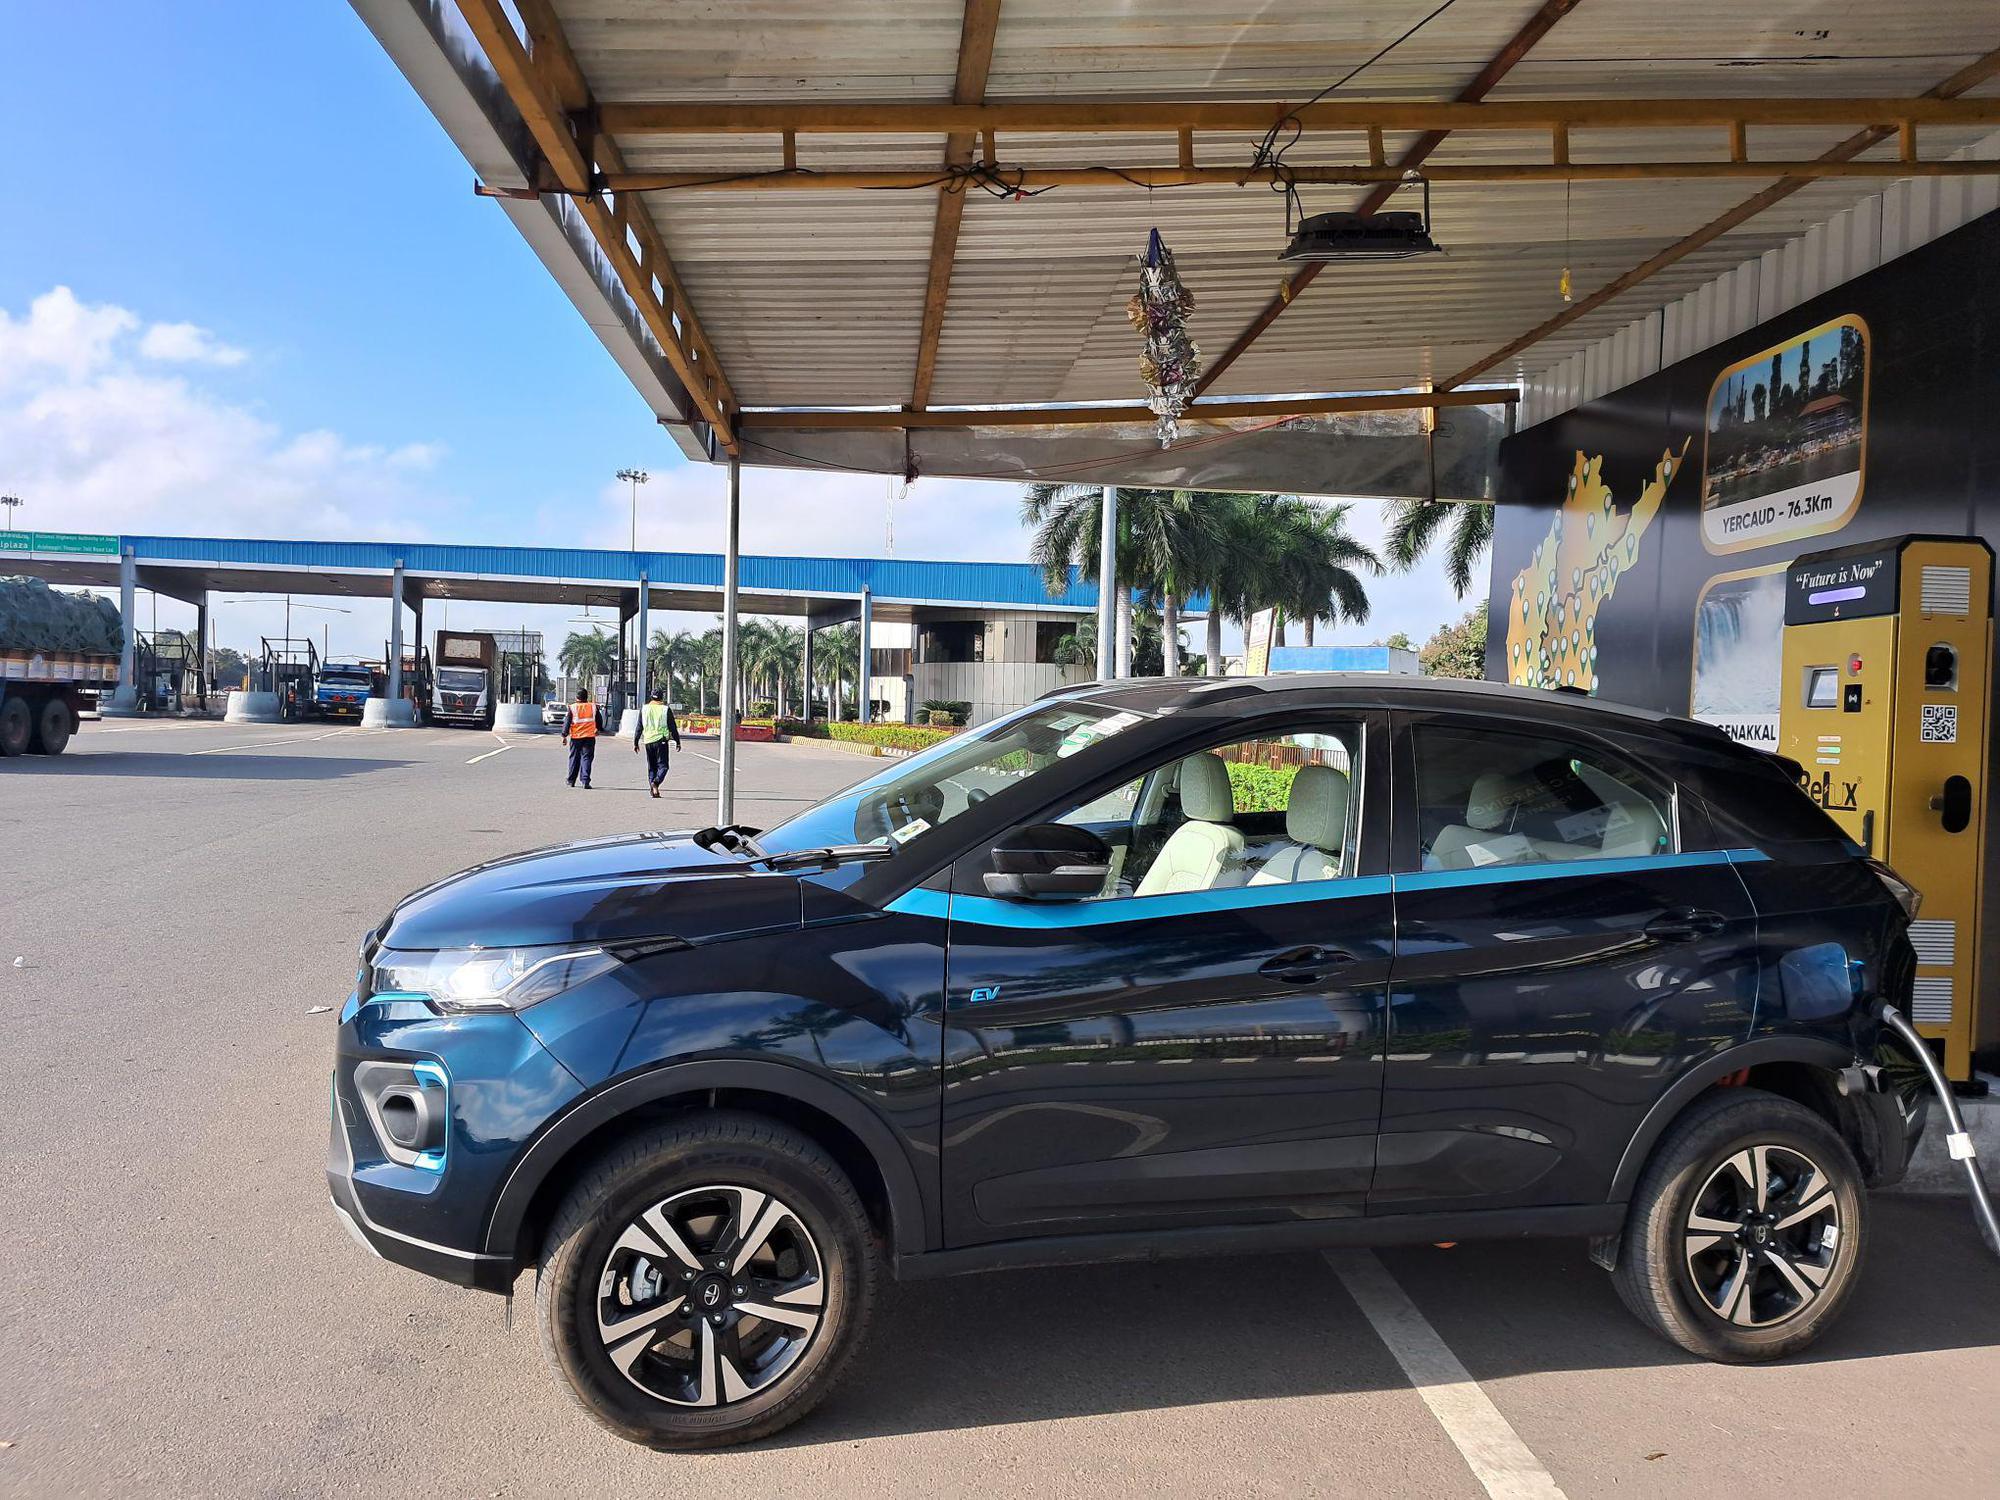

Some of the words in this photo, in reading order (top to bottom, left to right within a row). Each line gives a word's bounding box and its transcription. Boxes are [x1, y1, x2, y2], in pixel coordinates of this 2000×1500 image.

[1723, 507, 1775, 533] YERCAUD
[1788, 495, 1832, 519] 76.3Km
[1839, 567, 1848, 583] is
[970, 986, 1001, 1002] EV
